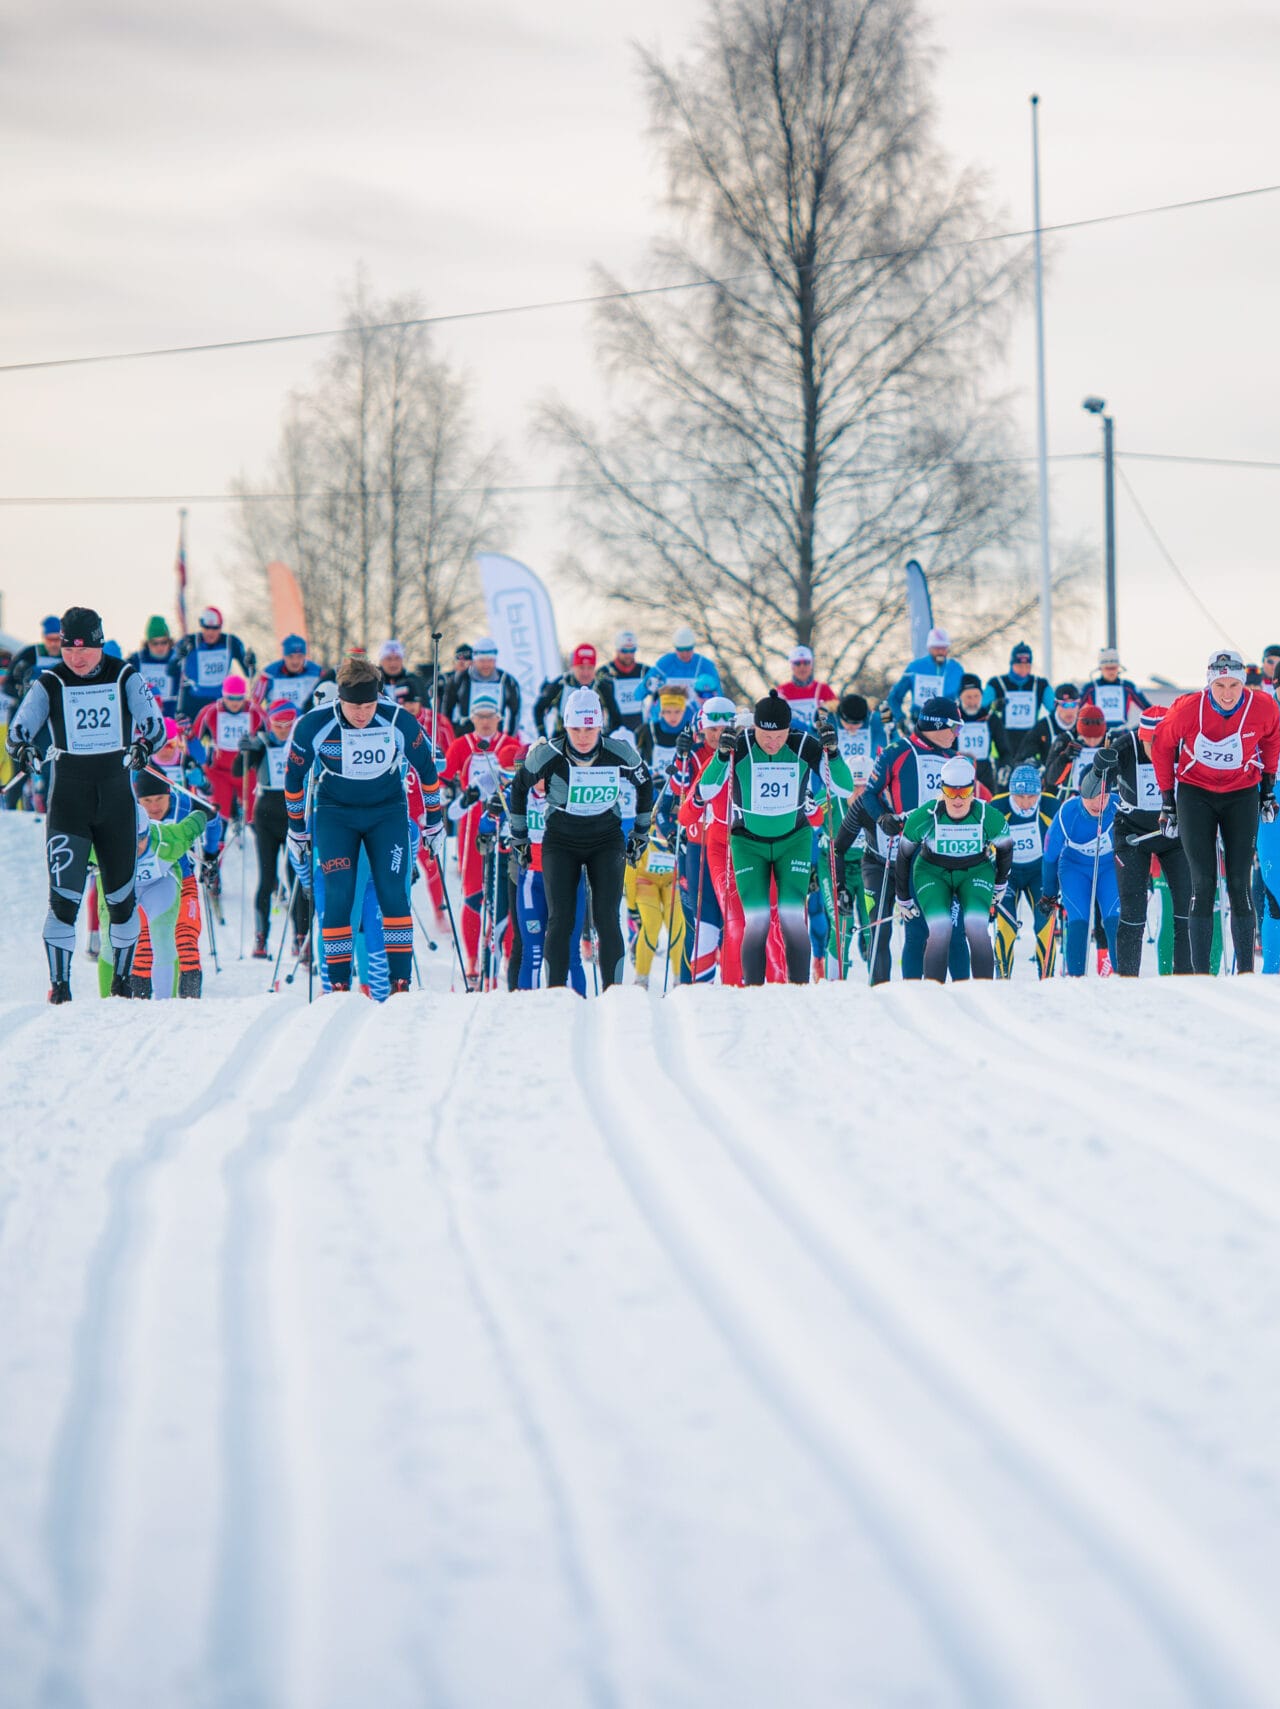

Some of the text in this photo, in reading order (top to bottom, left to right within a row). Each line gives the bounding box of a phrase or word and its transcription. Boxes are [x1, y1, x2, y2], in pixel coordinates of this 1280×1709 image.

[1012, 705, 1031, 716] 279
[76, 707, 111, 729] 232
[760, 721, 777, 729] LIMA
[964, 737, 984, 748] 319
[844, 743, 865, 756] 286
[352, 749, 386, 765] 290
[1202, 750, 1234, 763] 278
[927, 773, 942, 790] 32
[574, 787, 615, 804] 1026
[760, 782, 790, 798] 291
[1146, 783, 1162, 796] 27
[529, 813, 545, 829] 10
[939, 840, 979, 853] 1032
